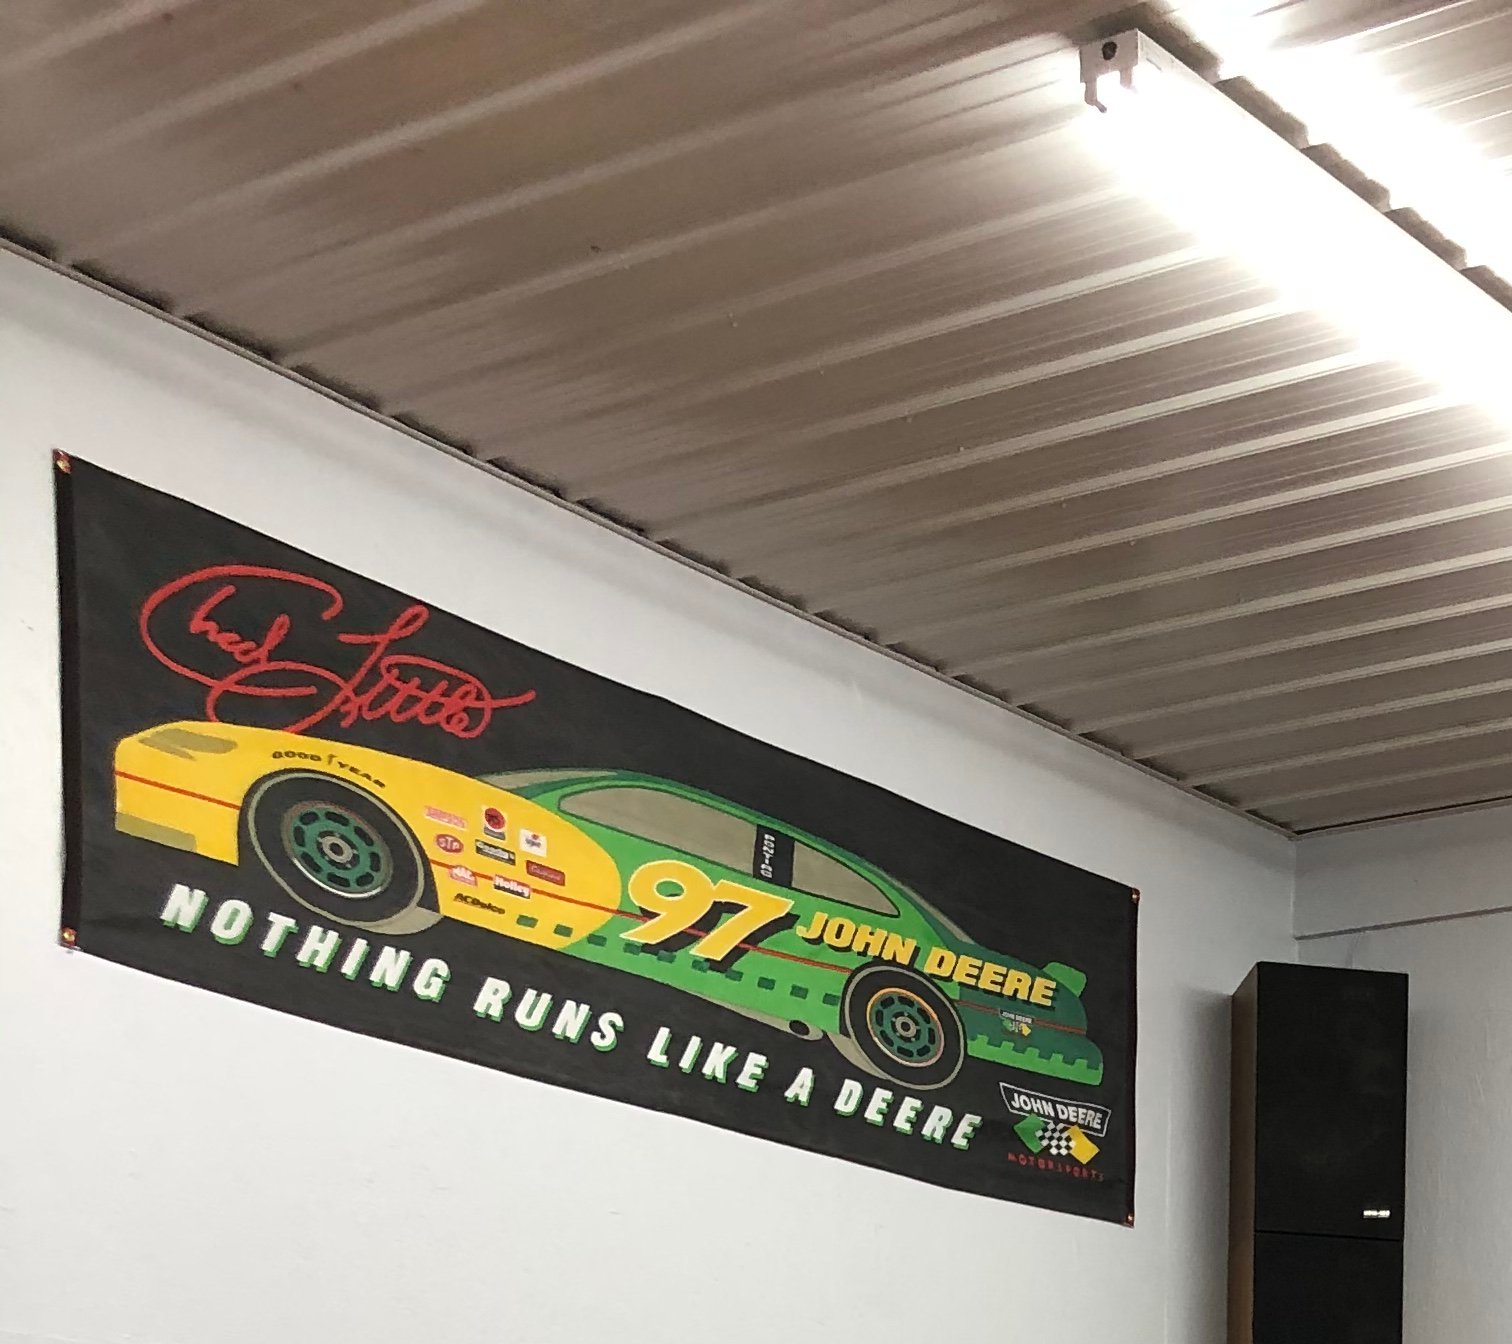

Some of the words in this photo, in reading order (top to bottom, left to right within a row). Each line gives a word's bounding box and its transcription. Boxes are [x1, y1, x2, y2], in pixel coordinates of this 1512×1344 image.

[437, 836, 461, 851] STP
[619, 860, 795, 962] 97
[796, 911, 917, 965] JOHN
[925, 945, 1057, 1006] DEERE
[160, 883, 453, 1002] NOTHING
[473, 977, 625, 1053] RUNS
[647, 1027, 768, 1092] LIKE
[785, 1067, 817, 1105] A
[834, 1079, 983, 1150] DEERE
[1011, 1092, 1053, 1117] JOHN
[1056, 1103, 1103, 1130] DEERE
[1007, 1151, 1104, 1181] MOTORSPORTS
